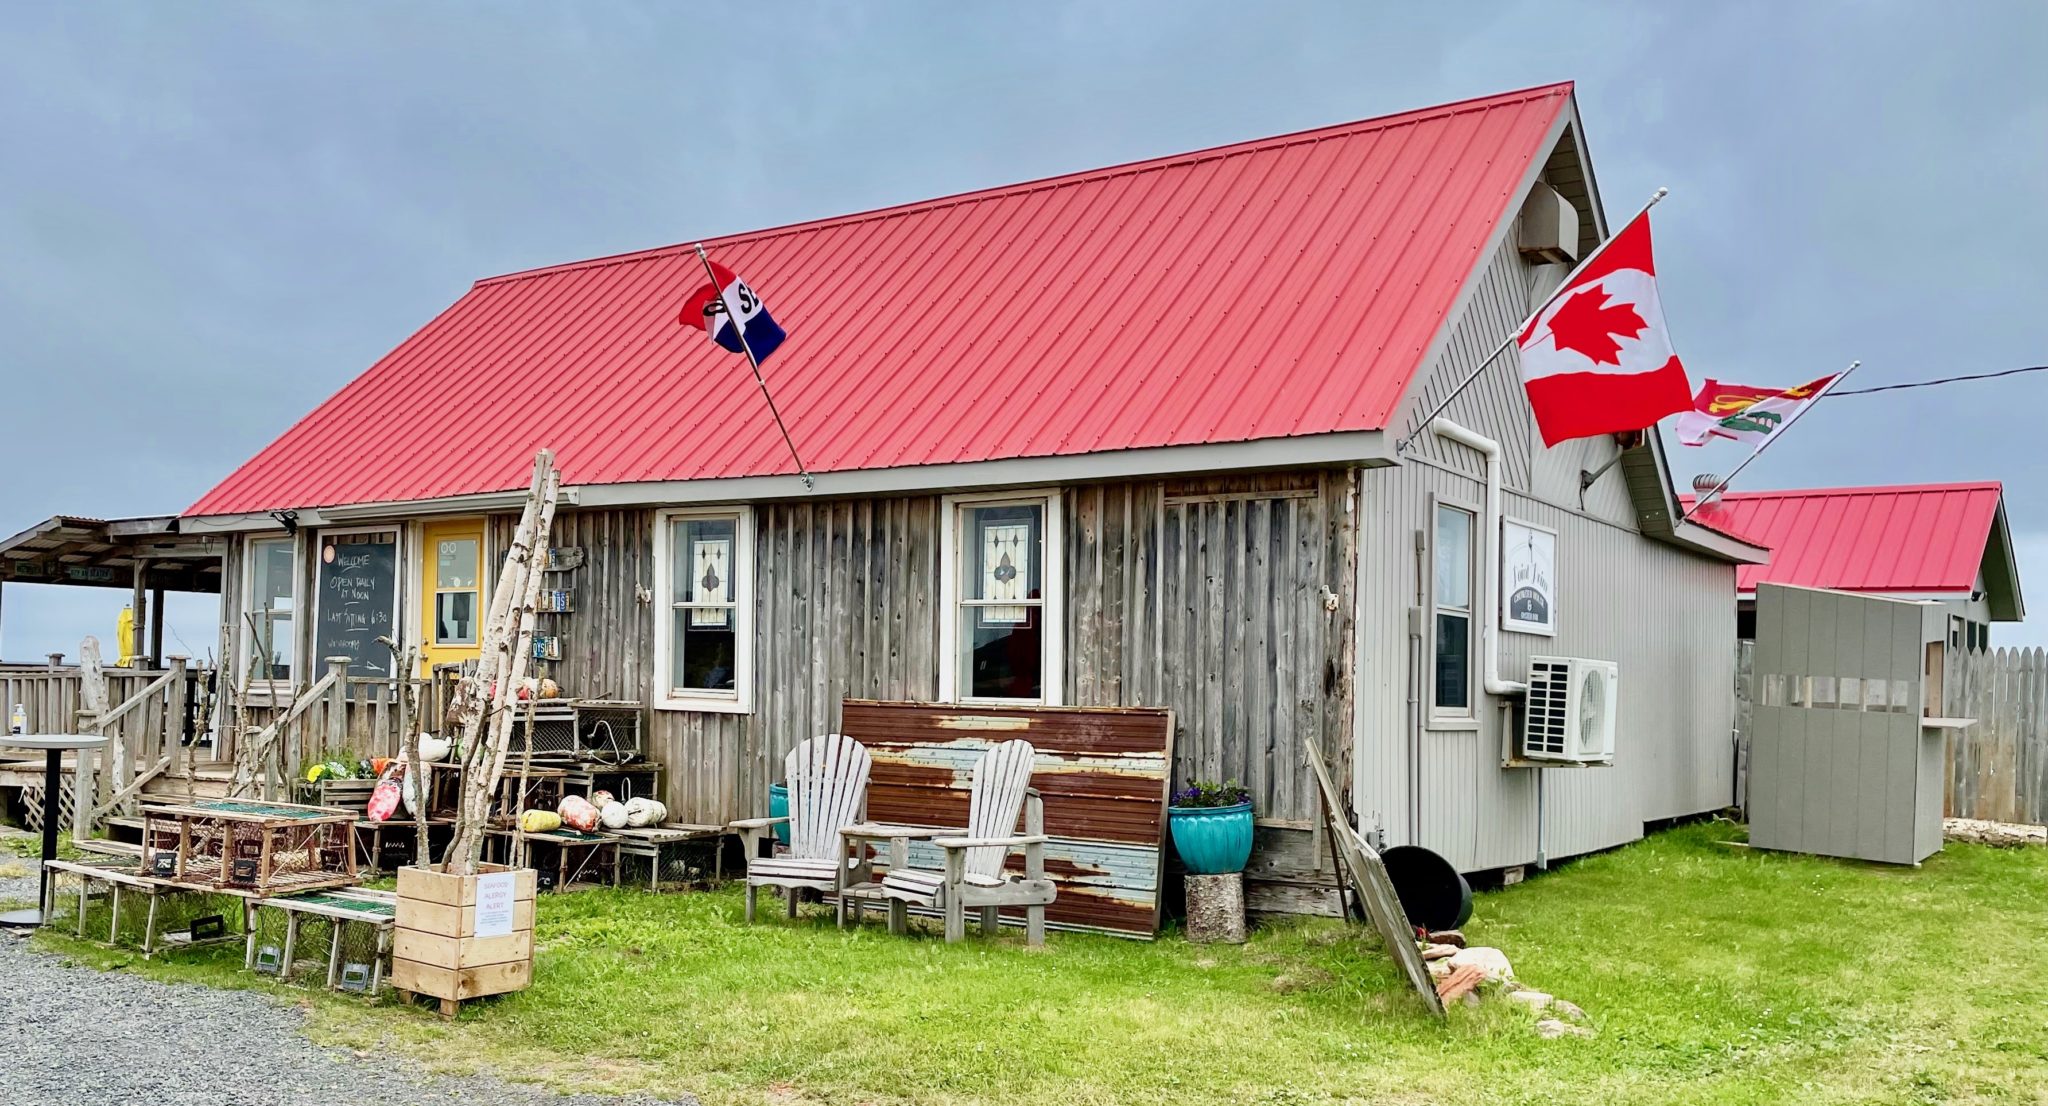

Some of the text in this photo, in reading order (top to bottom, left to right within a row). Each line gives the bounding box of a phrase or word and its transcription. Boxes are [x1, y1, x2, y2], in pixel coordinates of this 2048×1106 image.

[337, 554, 369, 567] WELCOME
[330, 576, 375, 591] OPEN DAILY
[341, 588, 369, 600] AT NOON
[328, 608, 342, 623] LAST
[371, 610, 387, 624] 6:30
